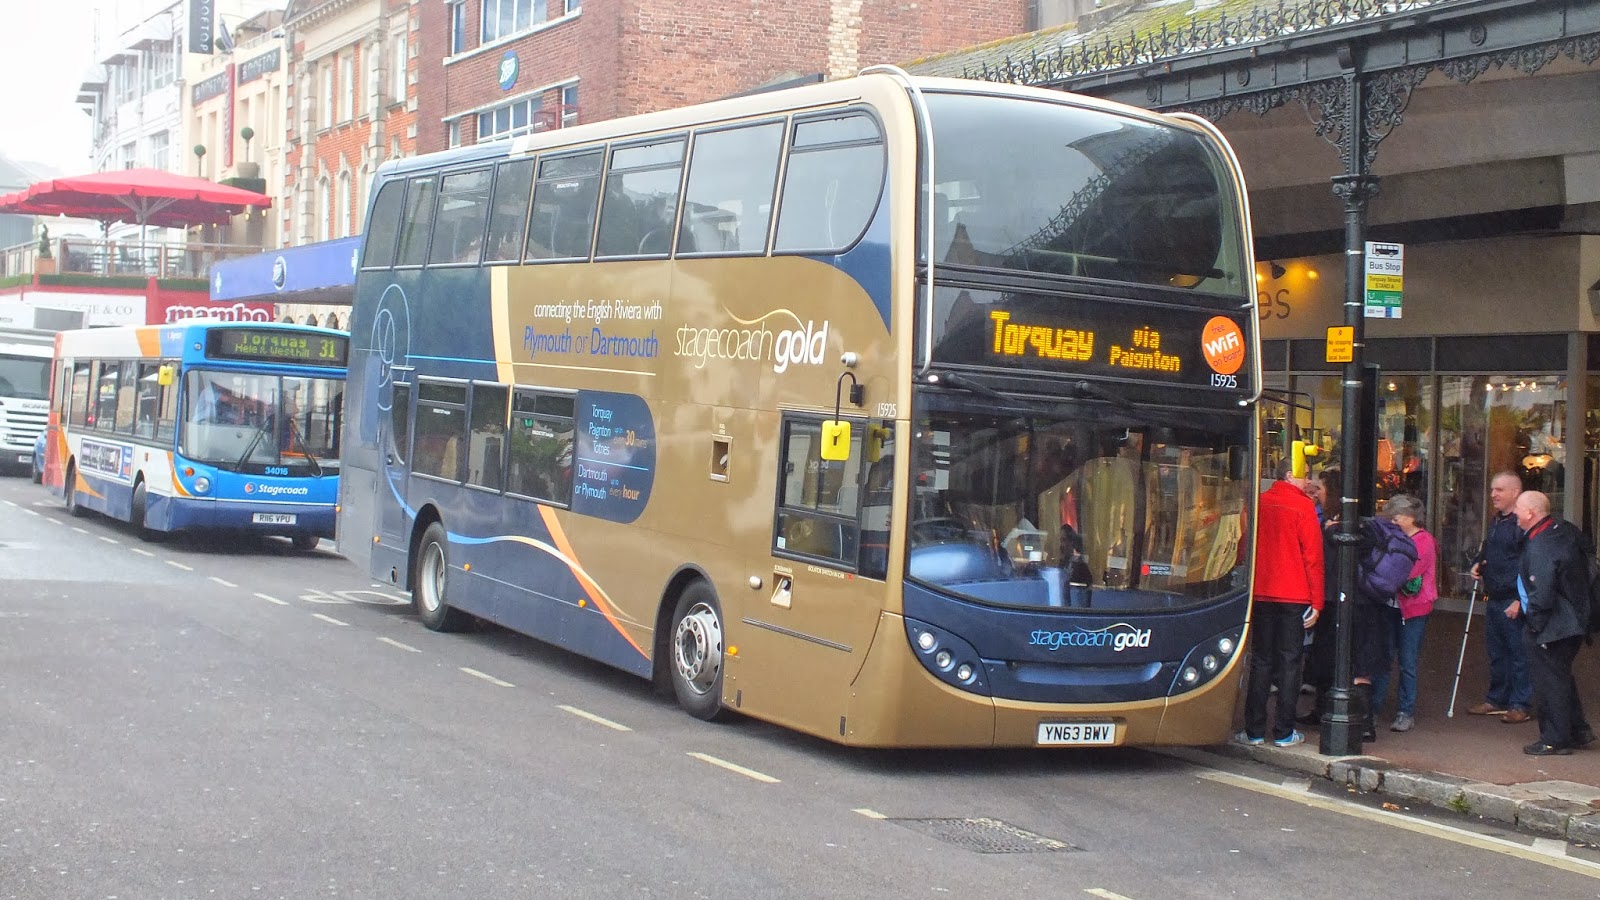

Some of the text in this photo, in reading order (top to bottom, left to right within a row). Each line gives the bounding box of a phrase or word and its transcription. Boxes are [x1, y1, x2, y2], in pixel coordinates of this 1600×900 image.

[200, 0, 210, 52] OFTOP
[1369, 261, 1401, 273] Bus Stop
[115, 305, 133, 316] CO
[534, 299, 663, 325] connecting the English Riviera with
[1258, 288, 1291, 320] es
[990, 310, 1094, 361] Torquay
[1133, 326, 1161, 349] via
[1211, 324, 1226, 334] free
[241, 334, 307, 349] Torquay
[319, 339, 336, 358] 31
[523, 325, 659, 360] Plymouth or Dartmouth
[674, 320, 829, 374] stagecoach gold
[1204, 331, 1240, 357] WiFi
[1109, 345, 1181, 373] Paignton
[1212, 348, 1242, 367] on board
[1210, 373, 1237, 388] 15925
[592, 404, 614, 422] Torquay
[877, 402, 897, 418] 15925
[588, 422, 612, 439] Paignton
[625, 430, 635, 446] 30
[592, 440, 610, 456] Totnes
[265, 466, 289, 475] 34016
[578, 464, 608, 482] Dartmouth
[258, 484, 309, 496] Stagecoach
[574, 482, 607, 500] or Plymouth
[622, 485, 640, 501] hour
[260, 514, 291, 523] R116 VPU
[1029, 628, 1152, 652] stagecoach gold
[1045, 726, 1110, 741] YN63 BWV
